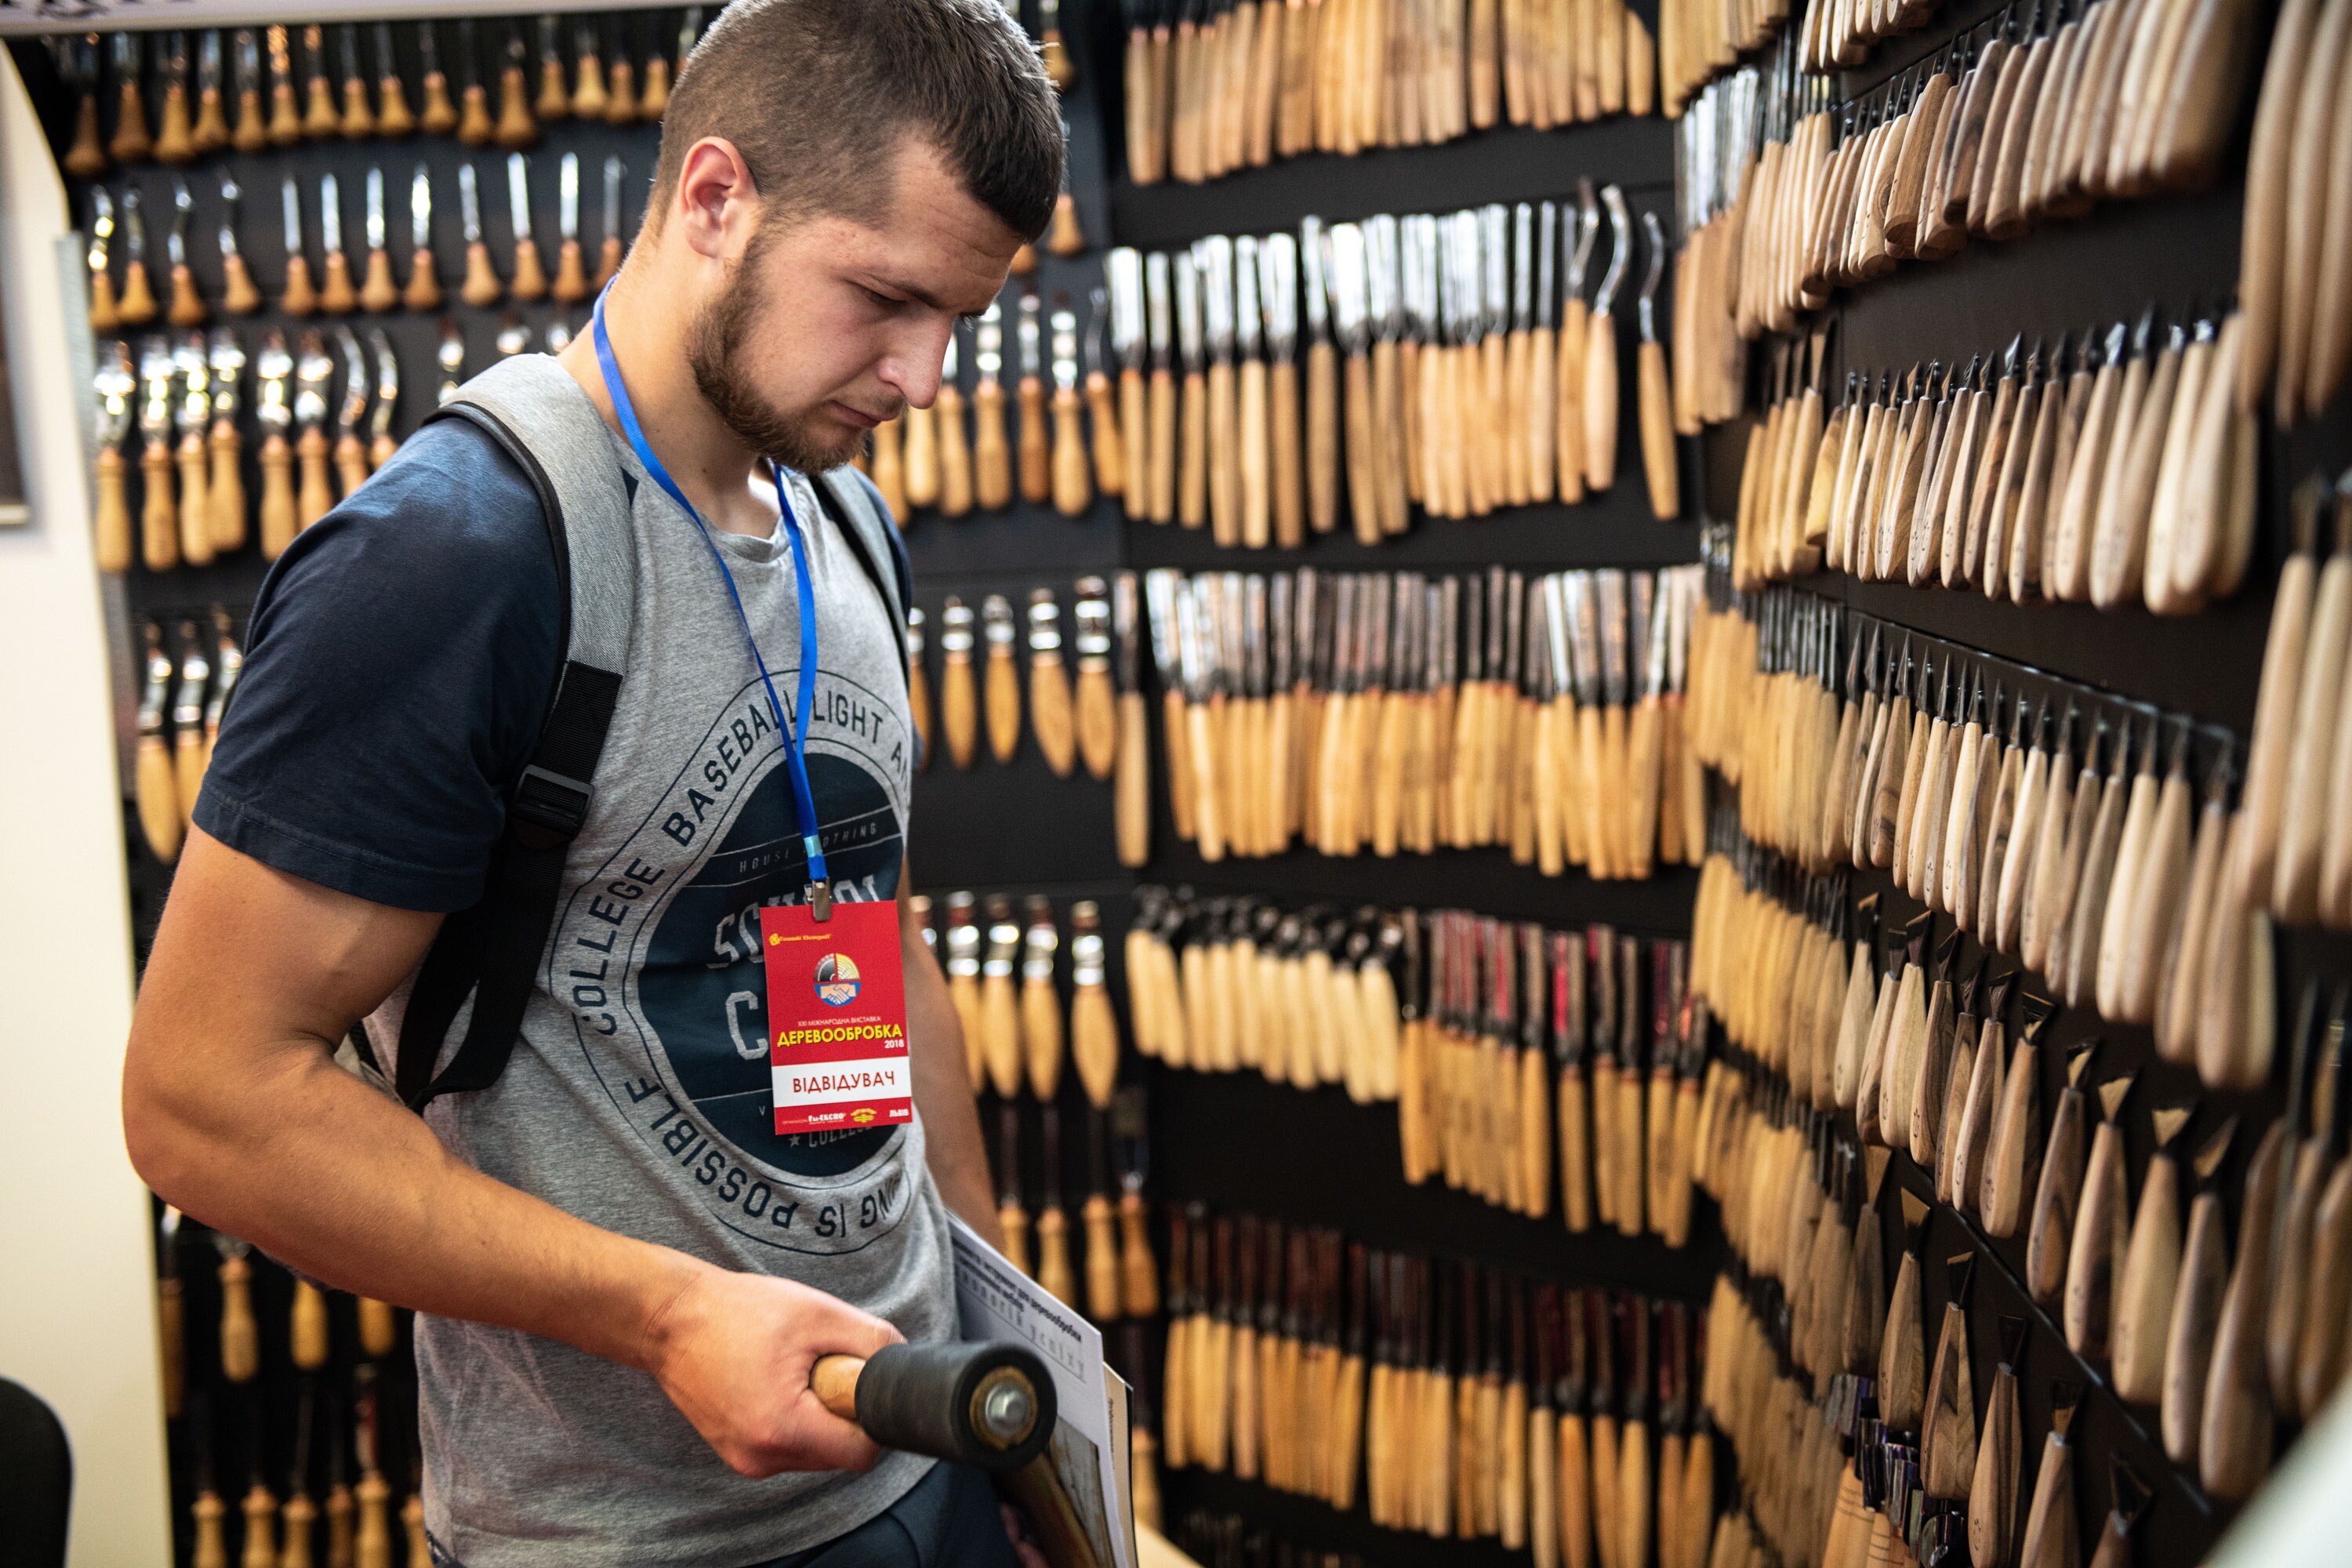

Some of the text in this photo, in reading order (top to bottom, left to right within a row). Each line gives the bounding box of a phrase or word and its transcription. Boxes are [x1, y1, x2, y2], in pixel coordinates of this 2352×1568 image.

[822, 822, 877, 848] OTHING
[569, 858, 666, 1036] COLLEGE
[661, 690, 797, 848] BASEBALL
[811, 690, 884, 744] LIGHT
[777, 1024, 903, 1047] ДЕРЕВООБРОБКА
[884, 1040, 905, 1049] 2018
[793, 1070, 895, 1094] ВІДВІДУВАЧ
[815, 1203, 846, 1238] IS
